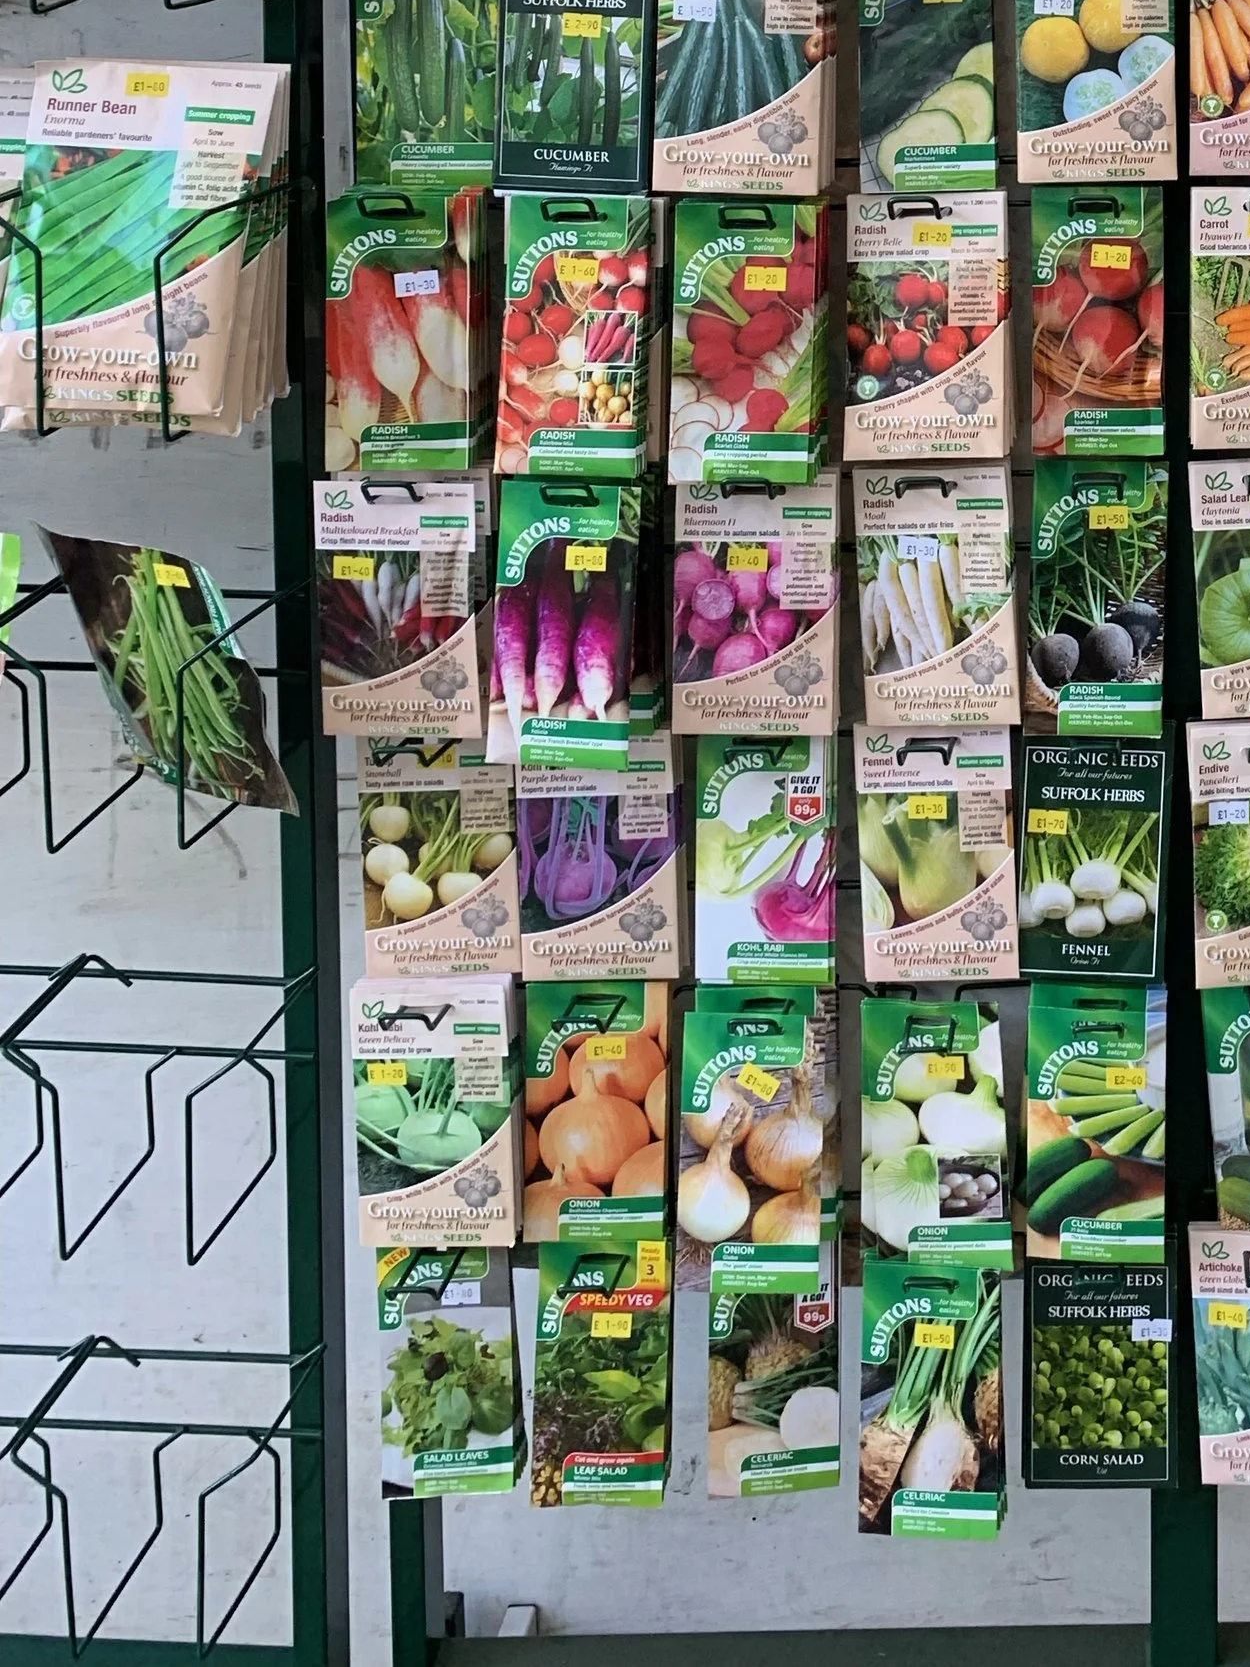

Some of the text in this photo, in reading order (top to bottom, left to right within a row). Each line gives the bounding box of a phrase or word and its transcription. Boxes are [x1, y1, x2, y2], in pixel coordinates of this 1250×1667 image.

[47, 98, 137, 114] Runner Bean
[44, 115, 85, 126] Enorma
[401, 145, 454, 154] CUCUMBER
[904, 146, 956, 156] CUCUMBER
[715, 434, 749, 442] RADISH
[863, 499, 894, 508] Radish
[863, 512, 885, 520] Mooli
[1201, 507, 1240, 516] Claytonia
[321, 513, 353, 522] Radish
[684, 517, 724, 525] Bluemoon
[1070, 685, 1103, 694] RADISH
[863, 757, 893, 766] Fennel
[1199, 763, 1229, 774] Endive
[521, 775, 583, 786] Purple Delicacy
[790, 775, 820, 786] GIVE IT
[793, 786, 816, 795] A GO!
[795, 805, 816, 816] 99p
[738, 943, 784, 952] KOHL RABI
[1062, 944, 1110, 957] FENNEL
[692, 1045, 756, 1107] SUTTONS
[1071, 1220, 1122, 1231] CUCUMBER
[723, 1246, 754, 1255] ONION
[1198, 1263, 1243, 1273] Artichoke
[423, 1451, 489, 1463] SALAD LEAVES
[750, 1451, 793, 1462] CELERIAC
[1060, 1454, 1144, 1466] CORN SALAD
[574, 1467, 627, 1475] LEAF SALAD
[903, 1493, 945, 1502] CELERIAC
